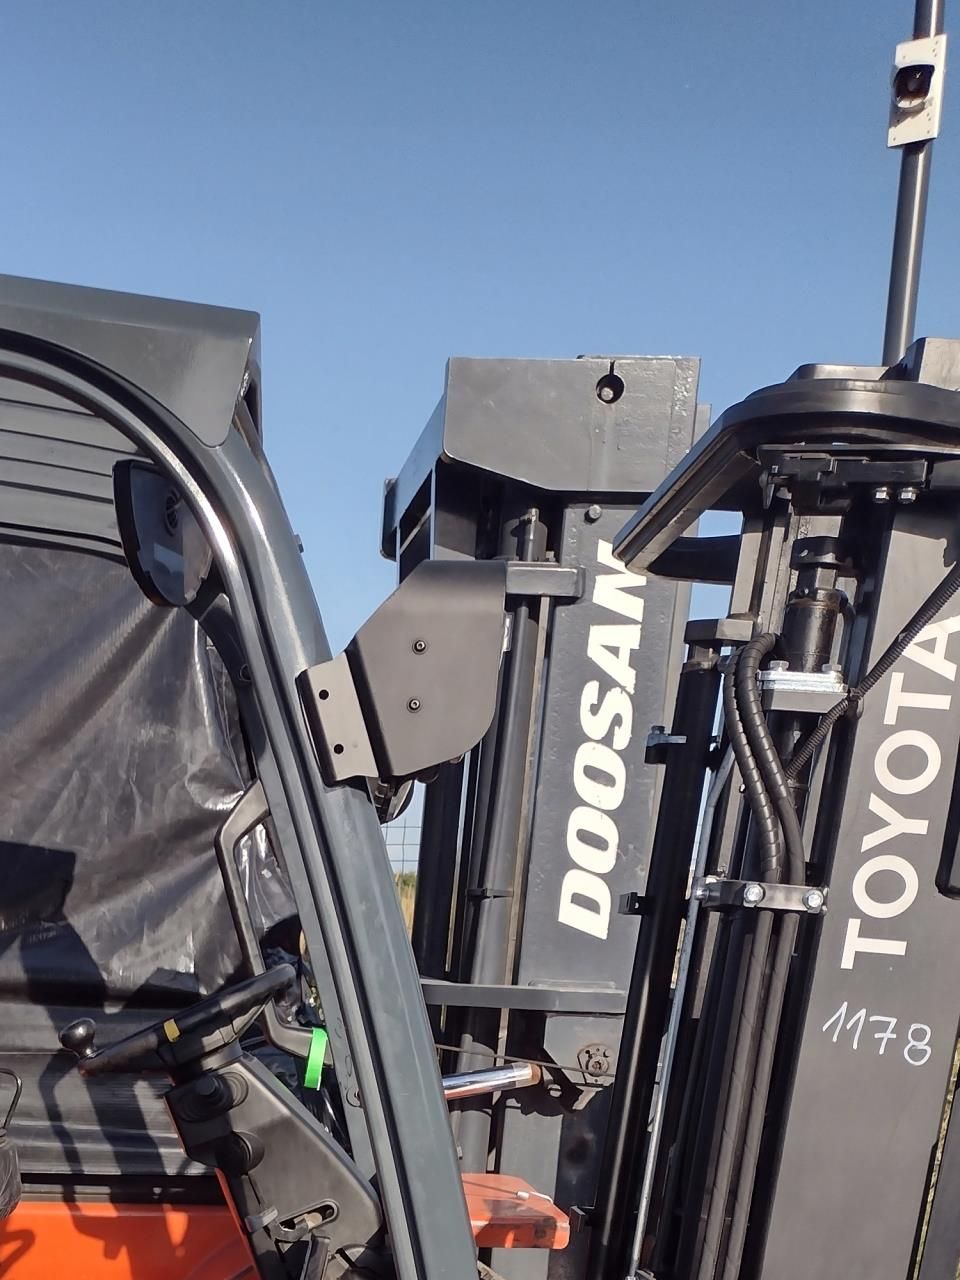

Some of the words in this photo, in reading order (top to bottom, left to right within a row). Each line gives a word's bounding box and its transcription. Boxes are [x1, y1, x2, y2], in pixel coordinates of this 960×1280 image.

[557, 539, 647, 940] DOOSAN
[840, 615, 960, 970] TOYOTA
[822, 1001, 932, 1067] 1178
